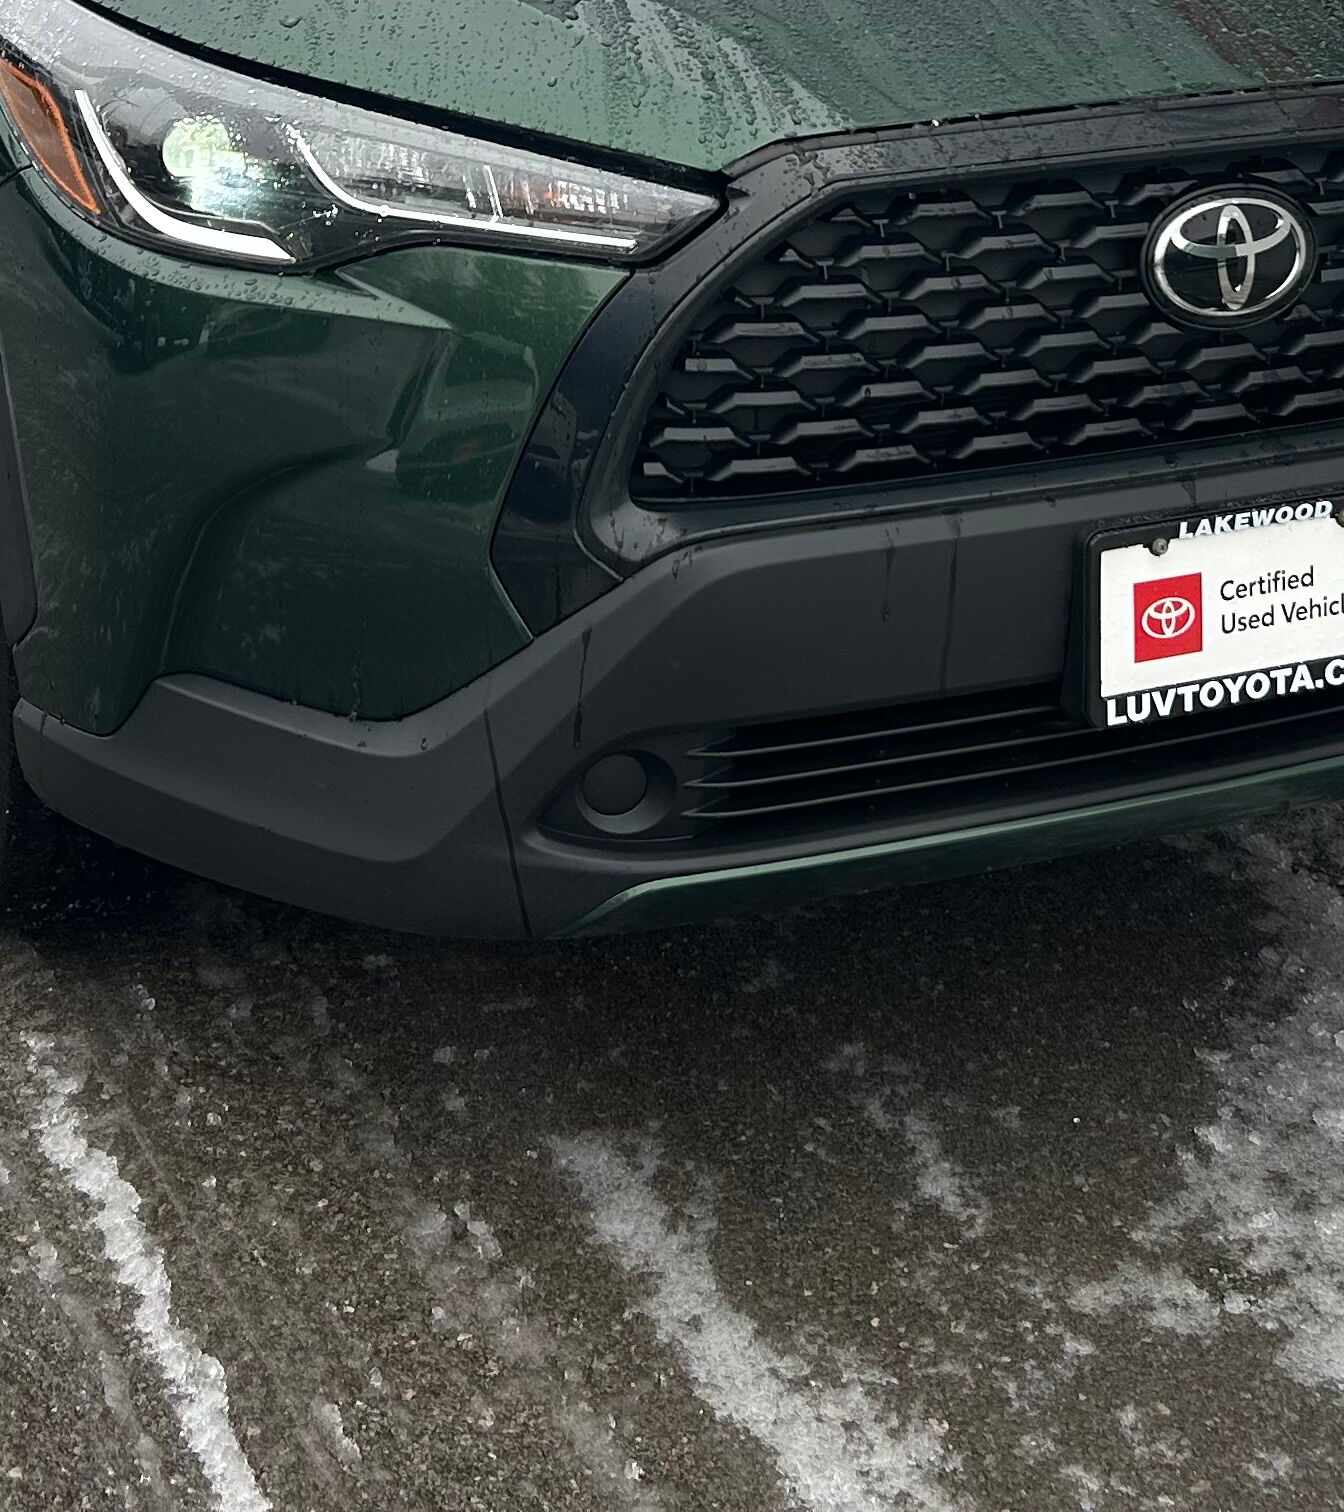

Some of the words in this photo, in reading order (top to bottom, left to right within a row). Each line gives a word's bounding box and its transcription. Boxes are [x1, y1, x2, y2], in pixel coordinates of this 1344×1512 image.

[1177, 499, 1334, 540] LAKEWOOD
[1219, 565, 1315, 602] Certified
[1220, 607, 1275, 635] Used
